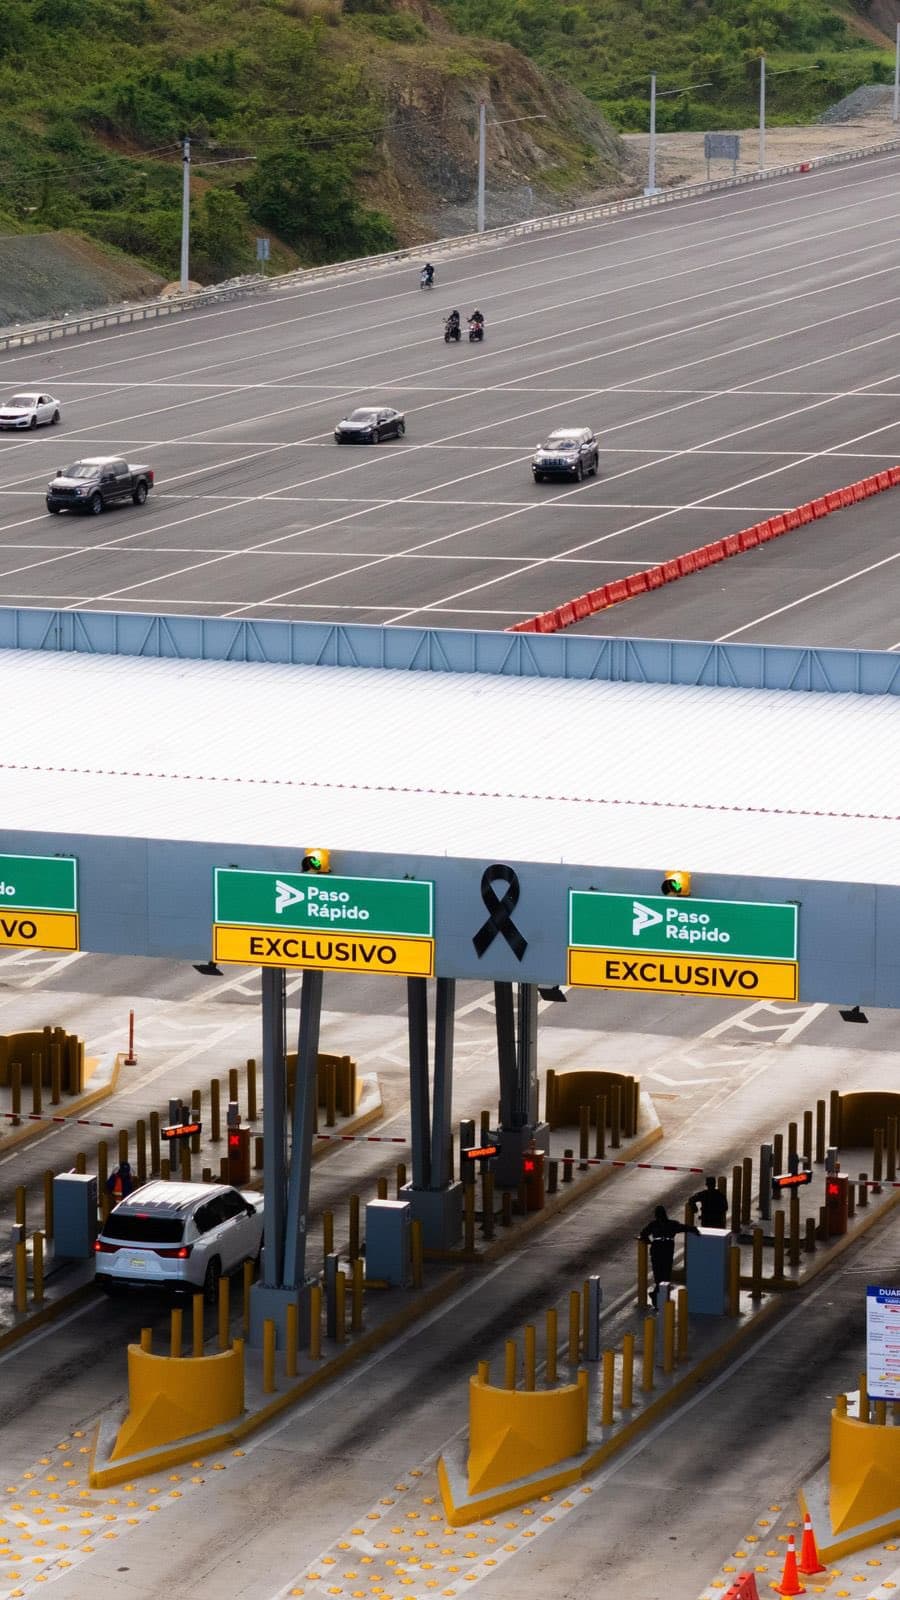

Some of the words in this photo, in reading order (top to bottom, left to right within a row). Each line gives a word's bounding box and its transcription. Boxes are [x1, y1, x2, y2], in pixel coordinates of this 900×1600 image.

[307, 886, 350, 903] Paso
[307, 903, 370, 921] Rápido
[665, 908, 710, 924] Paso
[0, 919, 37, 939] VO
[665, 924, 731, 943] Rápido
[249, 936, 397, 965] EXCLUSIVO
[605, 960, 759, 989] EXCLUSIVO
